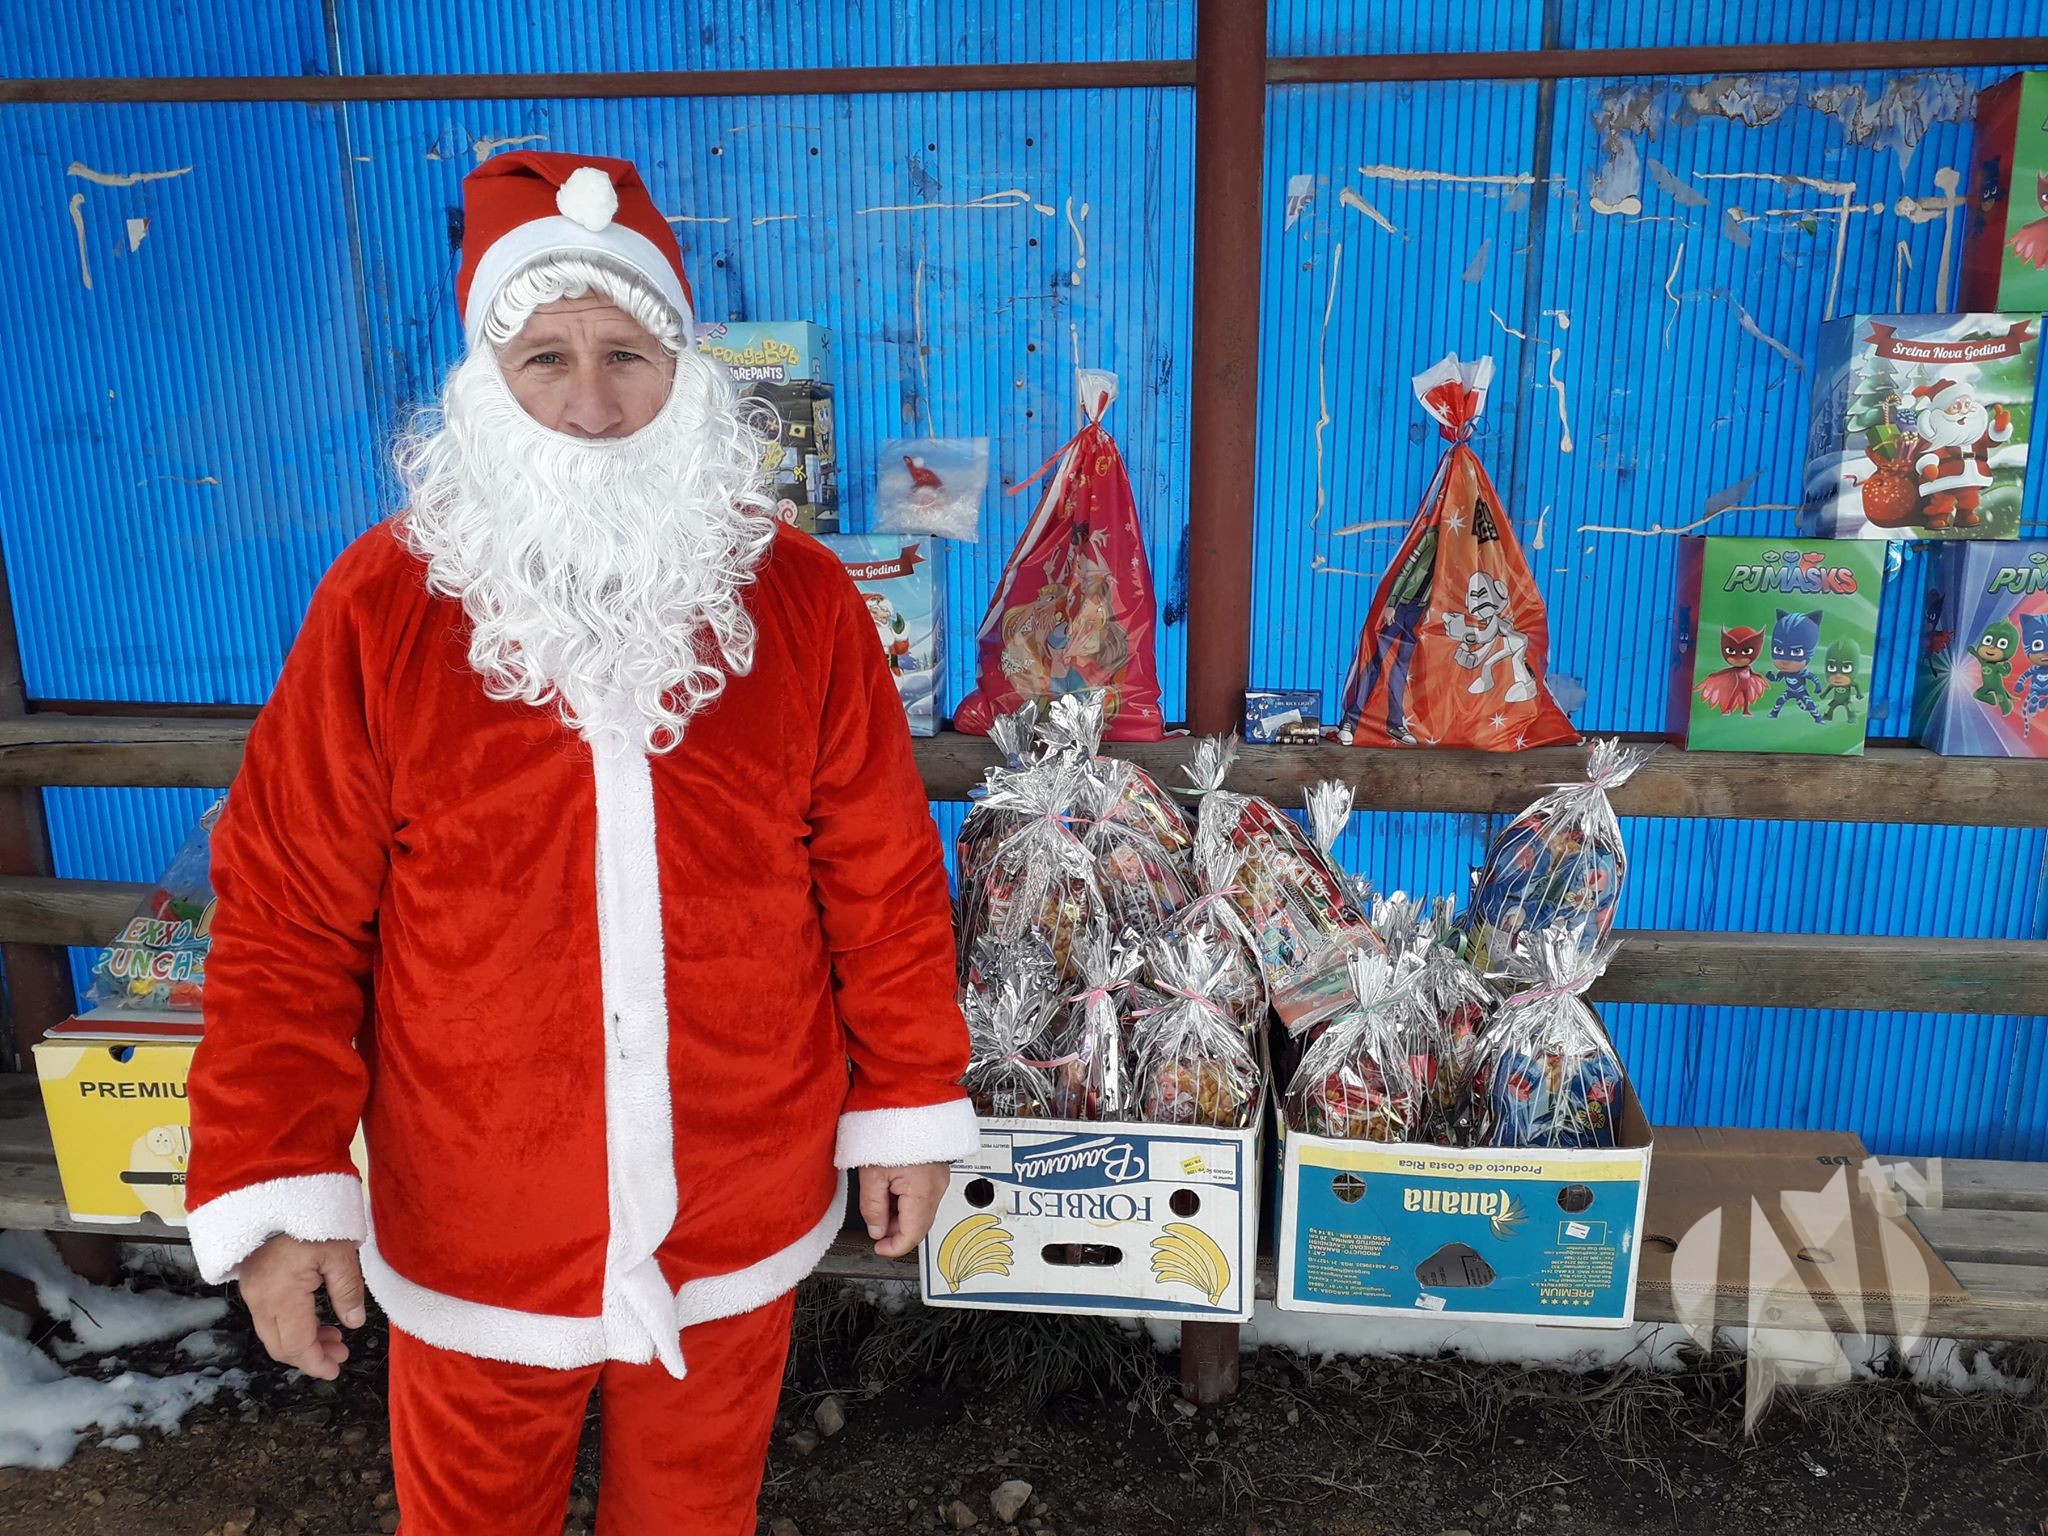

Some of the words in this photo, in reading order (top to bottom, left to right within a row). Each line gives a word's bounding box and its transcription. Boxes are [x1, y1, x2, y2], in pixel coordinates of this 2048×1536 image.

[1933, 347, 1962, 358] Nova
[1965, 344, 2006, 360] Godina
[730, 366, 783, 382] AREPANTS
[866, 564, 900, 578] Godina
[92, 948, 193, 981] PUNCH
[1014, 1144, 1144, 1182] Bananas
[1399, 1160, 1425, 1170] Rica
[1429, 1162, 1464, 1172] Costa
[1468, 1164, 1483, 1173] de
[1486, 1164, 1542, 1174] Producto
[1007, 1190, 1153, 1222] FORBEST
[1308, 1239, 1345, 1248] CAVENDISH
[1308, 1244, 1340, 1253] BANANAS
[1540, 1288, 1594, 1298] PREMIUM
